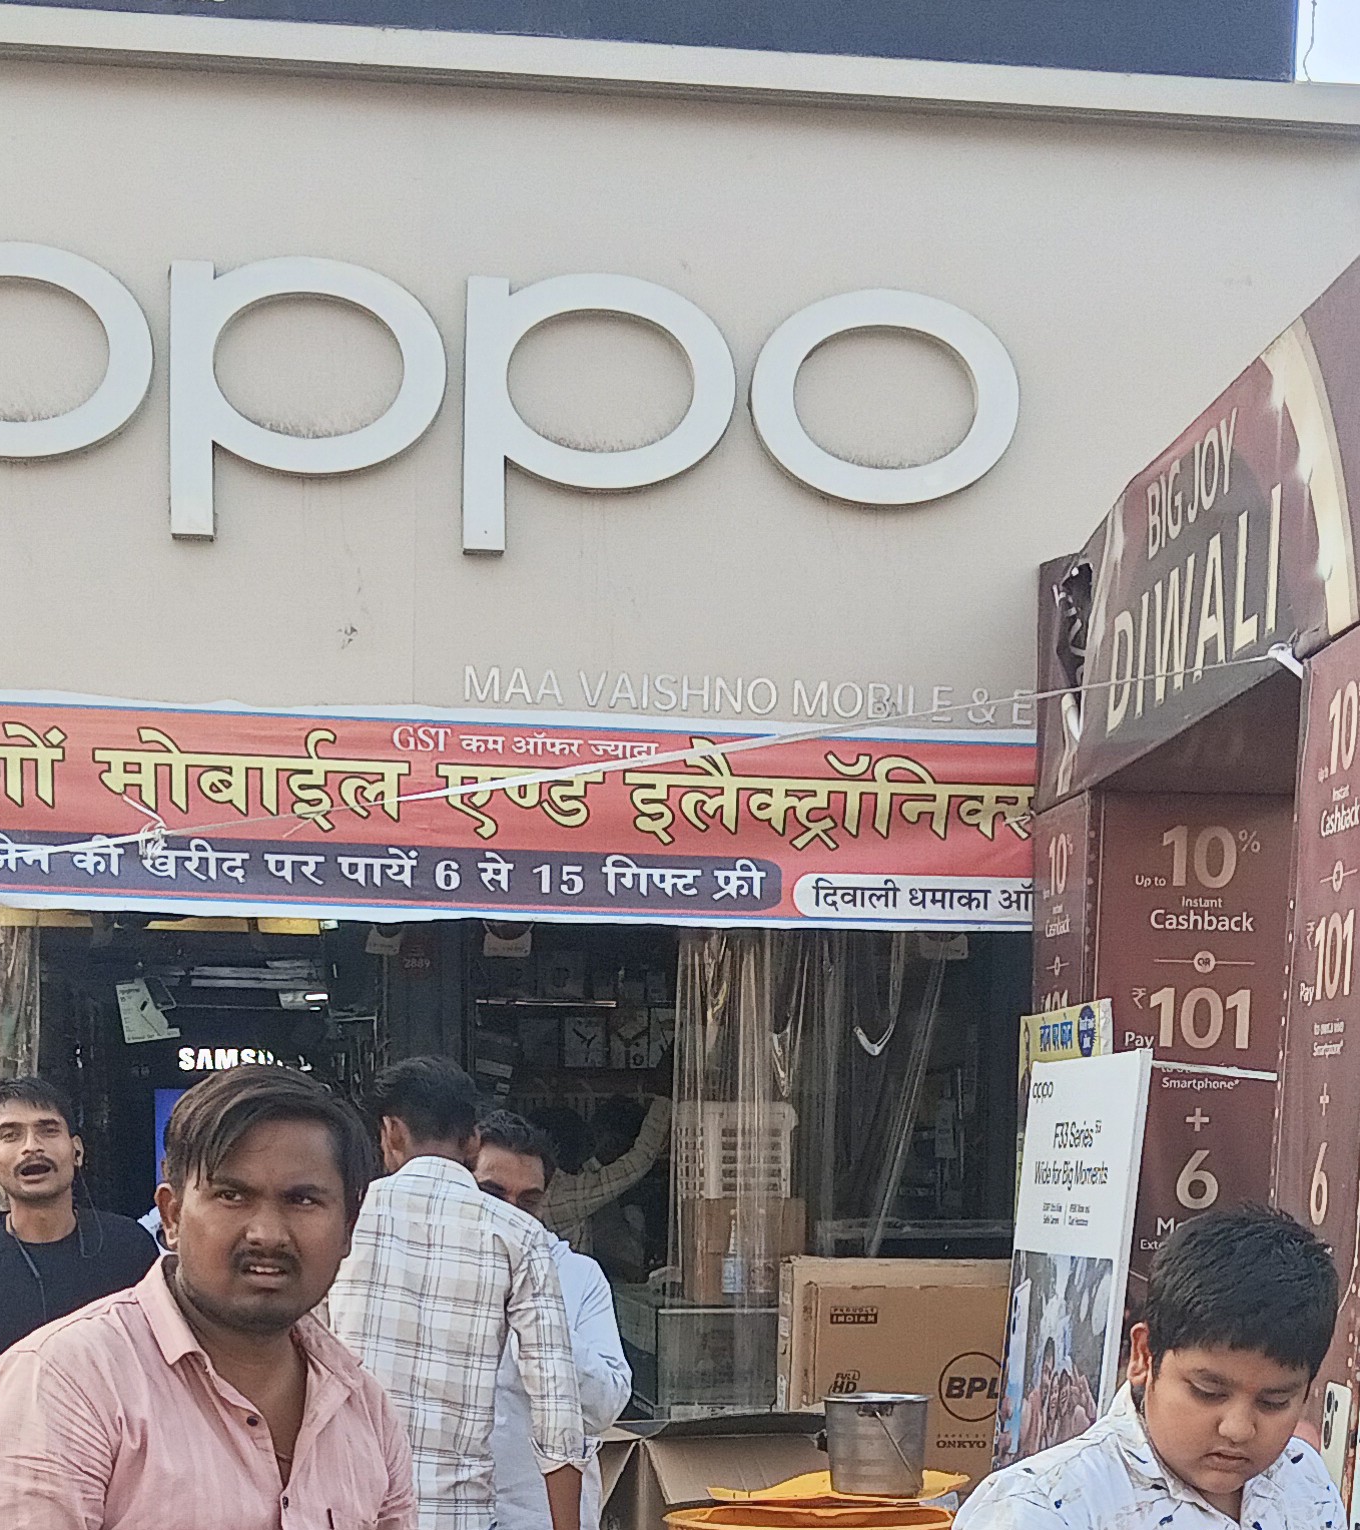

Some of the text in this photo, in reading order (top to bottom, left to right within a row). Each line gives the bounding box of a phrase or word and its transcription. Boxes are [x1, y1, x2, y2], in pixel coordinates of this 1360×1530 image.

[1147, 405, 1239, 553] BIG JOY
[1106, 483, 1283, 733] DIWALI
[462, 664, 564, 704] MAA
[579, 669, 778, 715] VAISHNO
[792, 680, 952, 724] MOBILE
[392, 726, 451, 754] GST
[460, 735, 504, 756] कम
[511, 731, 582, 759] ऑफर
[92, 722, 410, 832] मोबाईल
[438, 760, 606, 839] एण्ड
[72, 834, 123, 877] की
[141, 838, 246, 885] खरीद
[263, 855, 326, 883] पर
[338, 847, 417, 887] पायें
[435, 861, 462, 891] 6
[476, 853, 516, 893] से
[534, 864, 583, 896] 15
[602, 855, 702, 900] गिफ्ट
[713, 858, 766, 902] फ्री
[813, 875, 995, 913] दिवाली धमाका
[1181, 896, 1223, 909] Instant
[1150, 908, 1255, 934] Cashback
[1124, 1029, 1155, 1051] Pay
[1176, 1149, 1219, 1210] 6
[1310, 1142, 1329, 1226] 6
[832, 1381, 857, 1394] HD
[945, 1377, 1002, 1399] BPL
[936, 1440, 987, 1449] ONKYO
